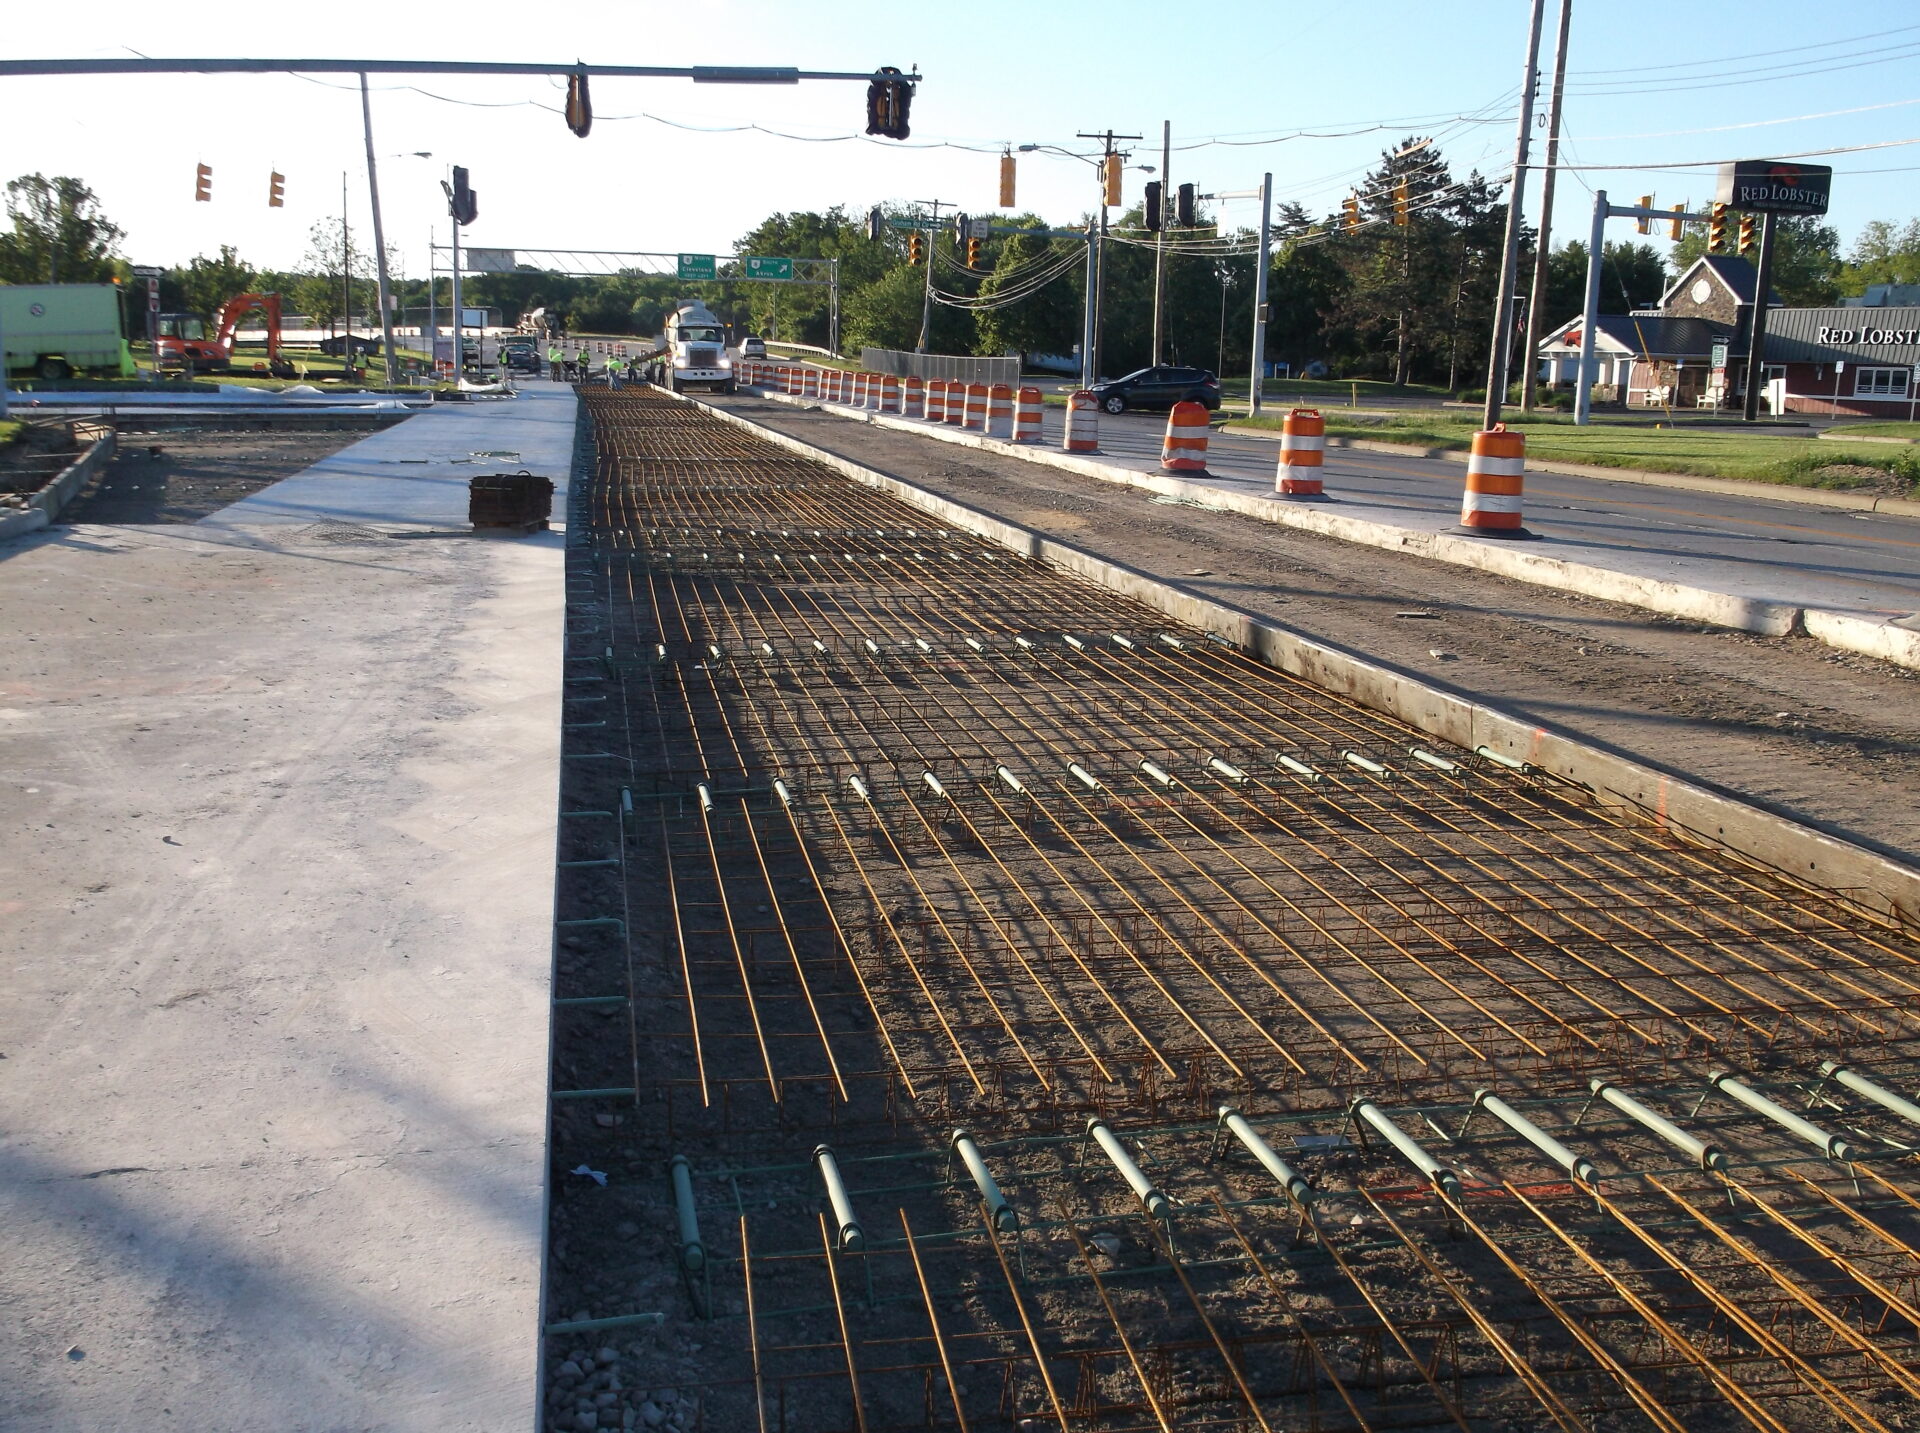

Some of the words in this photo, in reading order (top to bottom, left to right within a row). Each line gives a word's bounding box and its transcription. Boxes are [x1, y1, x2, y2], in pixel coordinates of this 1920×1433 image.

[1740, 186, 1769, 202] RED
[1771, 184, 1828, 207] LOBSTER
[1816, 326, 1854, 344] RED
